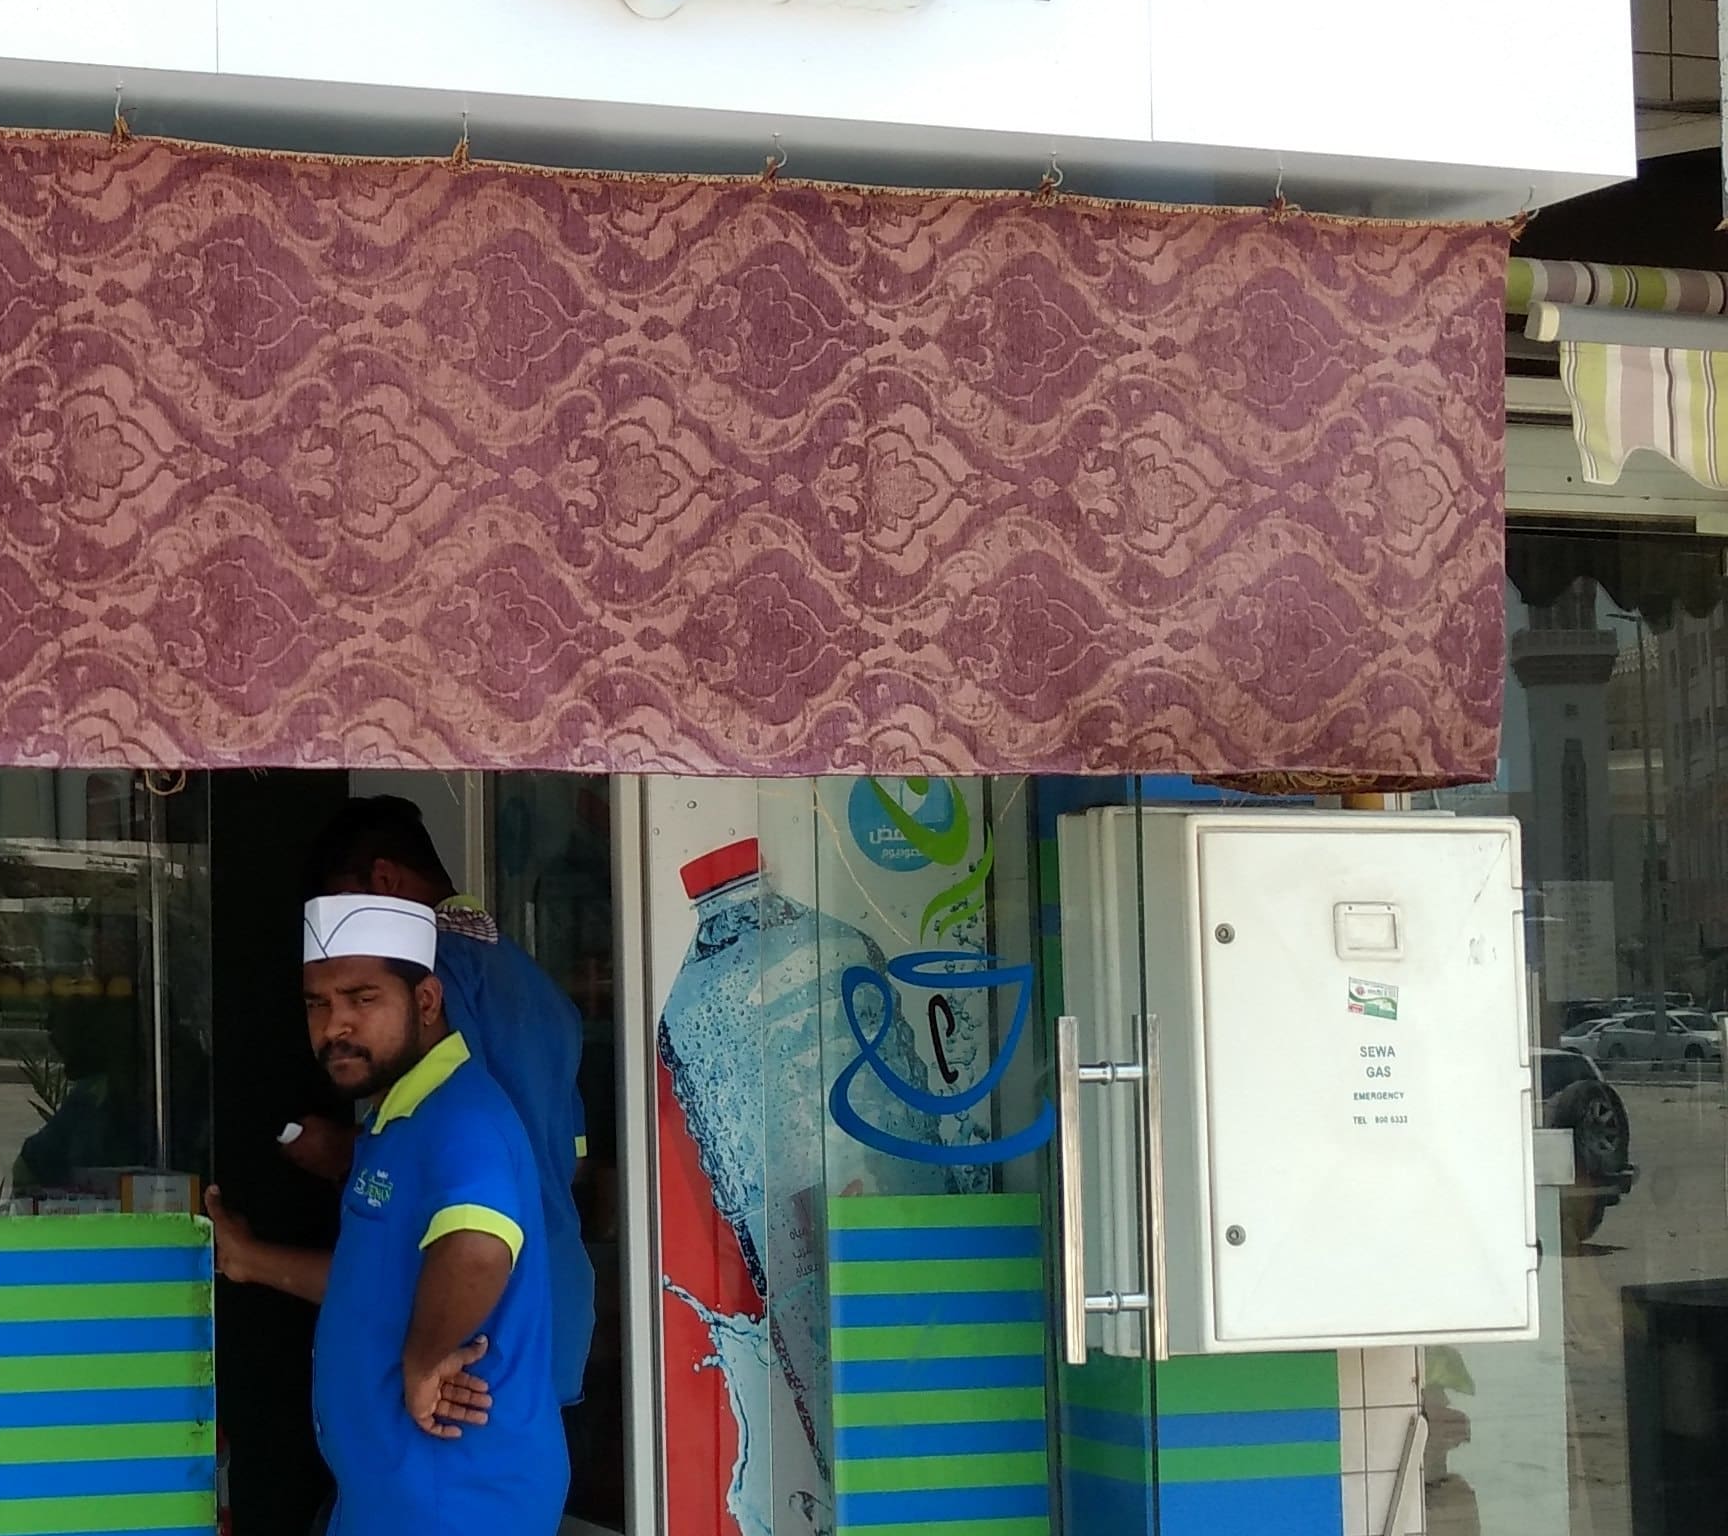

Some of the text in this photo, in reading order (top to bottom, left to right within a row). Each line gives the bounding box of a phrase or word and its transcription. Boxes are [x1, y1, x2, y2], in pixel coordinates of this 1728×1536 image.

[1359, 1045, 1396, 1058] SEWA
[1366, 1066, 1391, 1078] GAS
[1353, 1091, 1404, 1101] EMERGENCY
